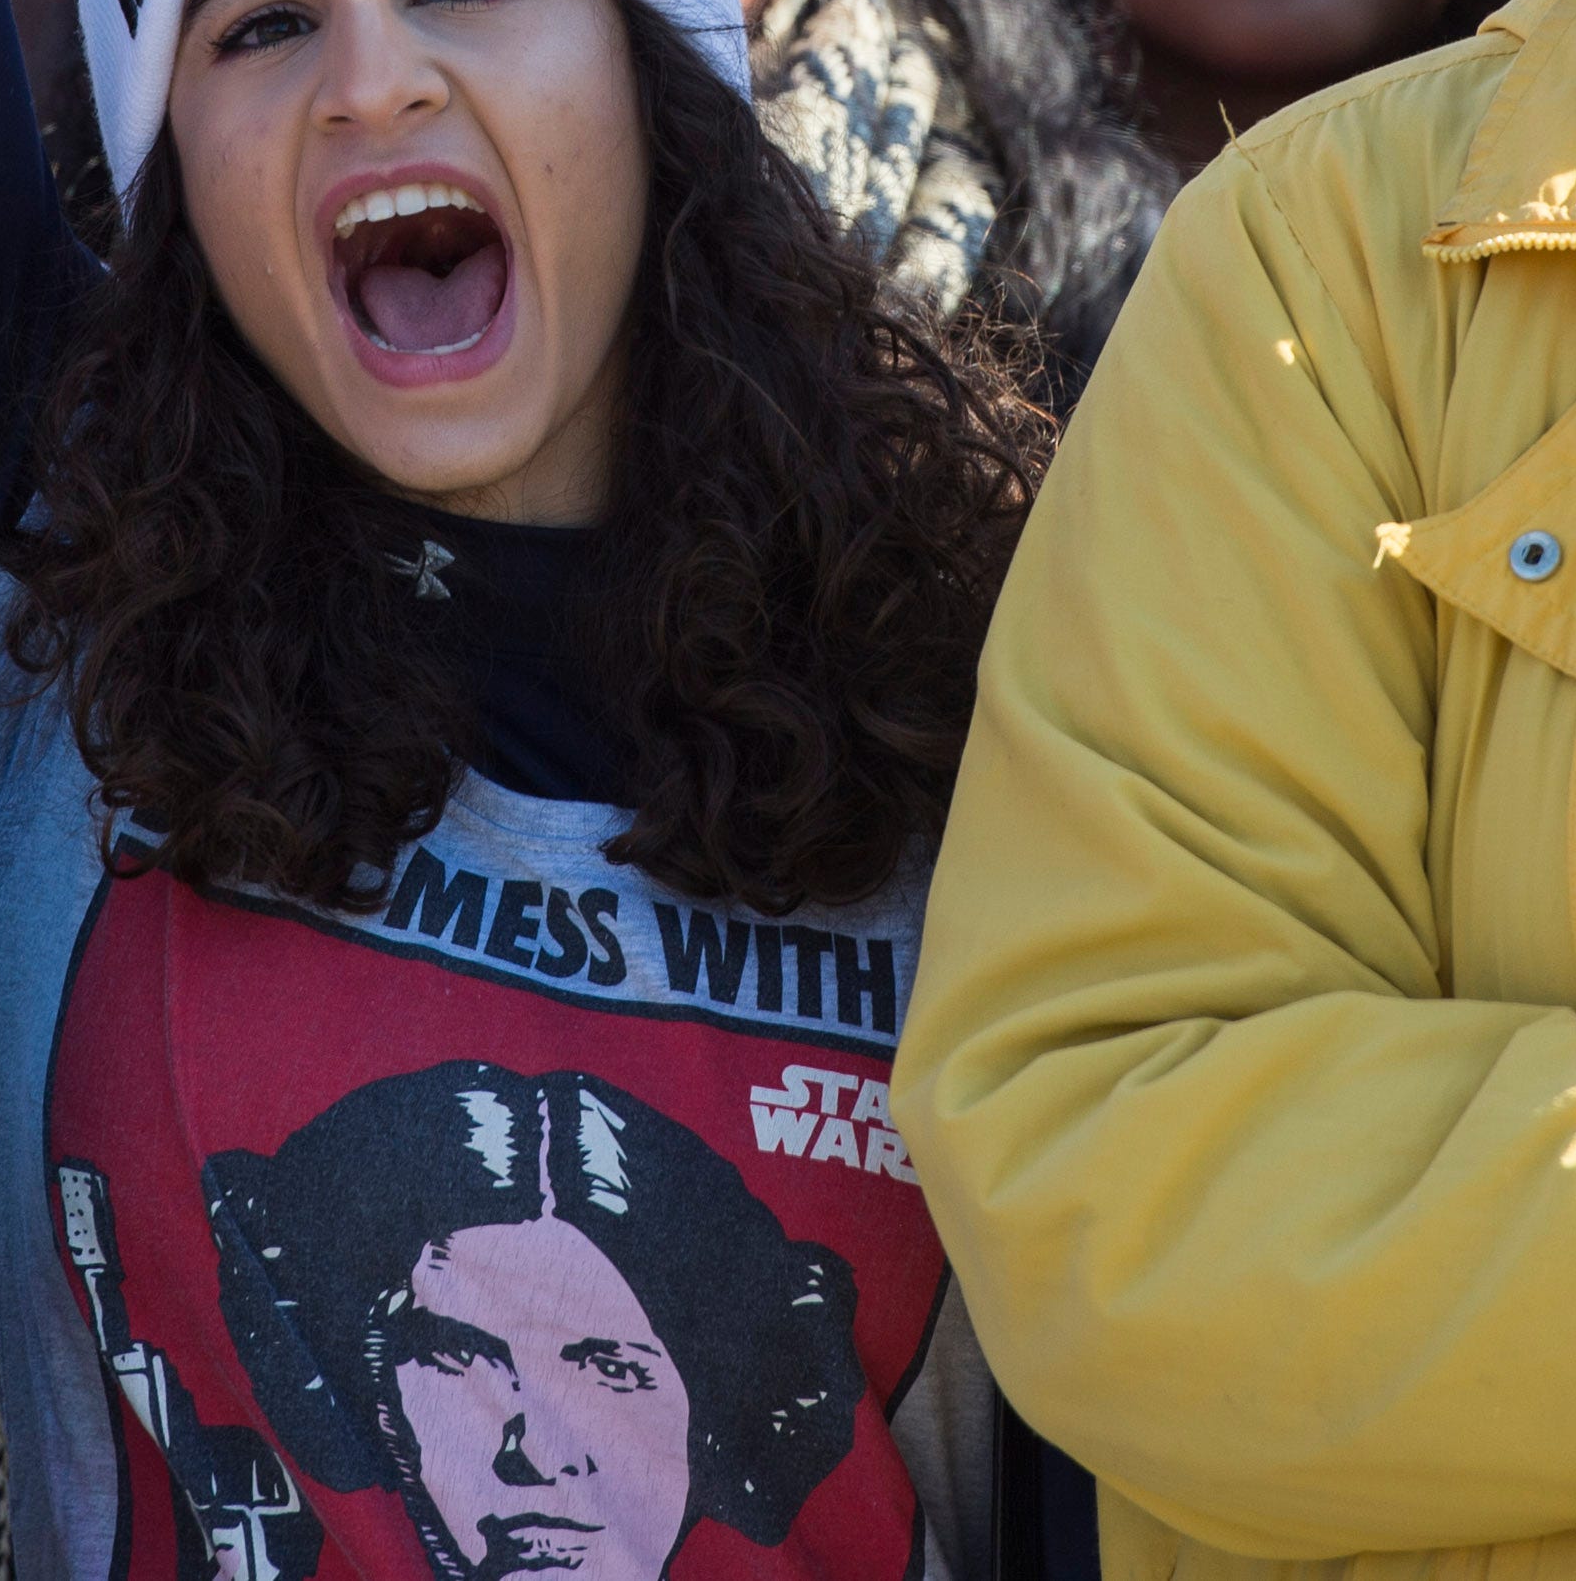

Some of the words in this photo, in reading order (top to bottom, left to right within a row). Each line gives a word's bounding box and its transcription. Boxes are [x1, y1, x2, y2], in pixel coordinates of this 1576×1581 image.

[382, 846, 628, 988] MESS
[650, 901, 897, 1037] WITH
[750, 1064, 899, 1130] STA
[750, 1103, 923, 1187] WAR
